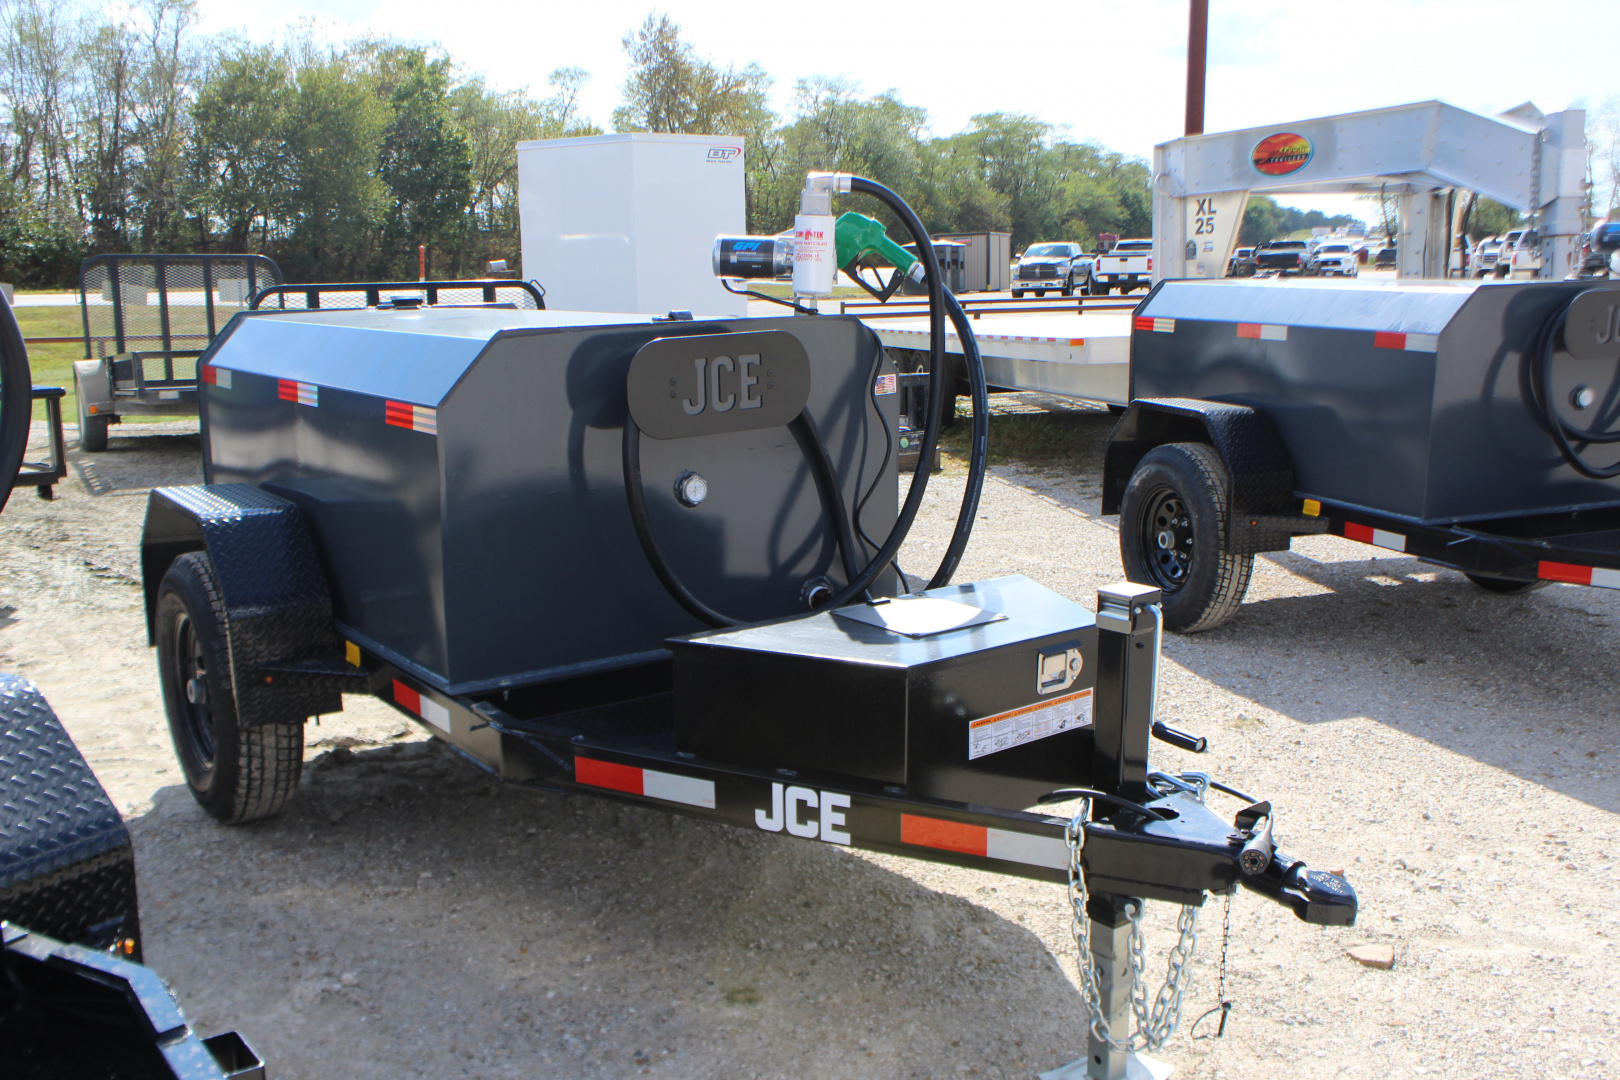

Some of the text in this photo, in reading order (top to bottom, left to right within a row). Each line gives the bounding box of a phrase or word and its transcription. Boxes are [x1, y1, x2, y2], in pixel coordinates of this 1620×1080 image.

[707, 148, 736, 159] BT
[1195, 198, 1217, 217] XL
[813, 231, 824, 239] TEK
[1195, 217, 1215, 236] 25
[733, 241, 761, 251] GPI
[683, 353, 762, 415] JCE
[755, 782, 850, 845] JCE
